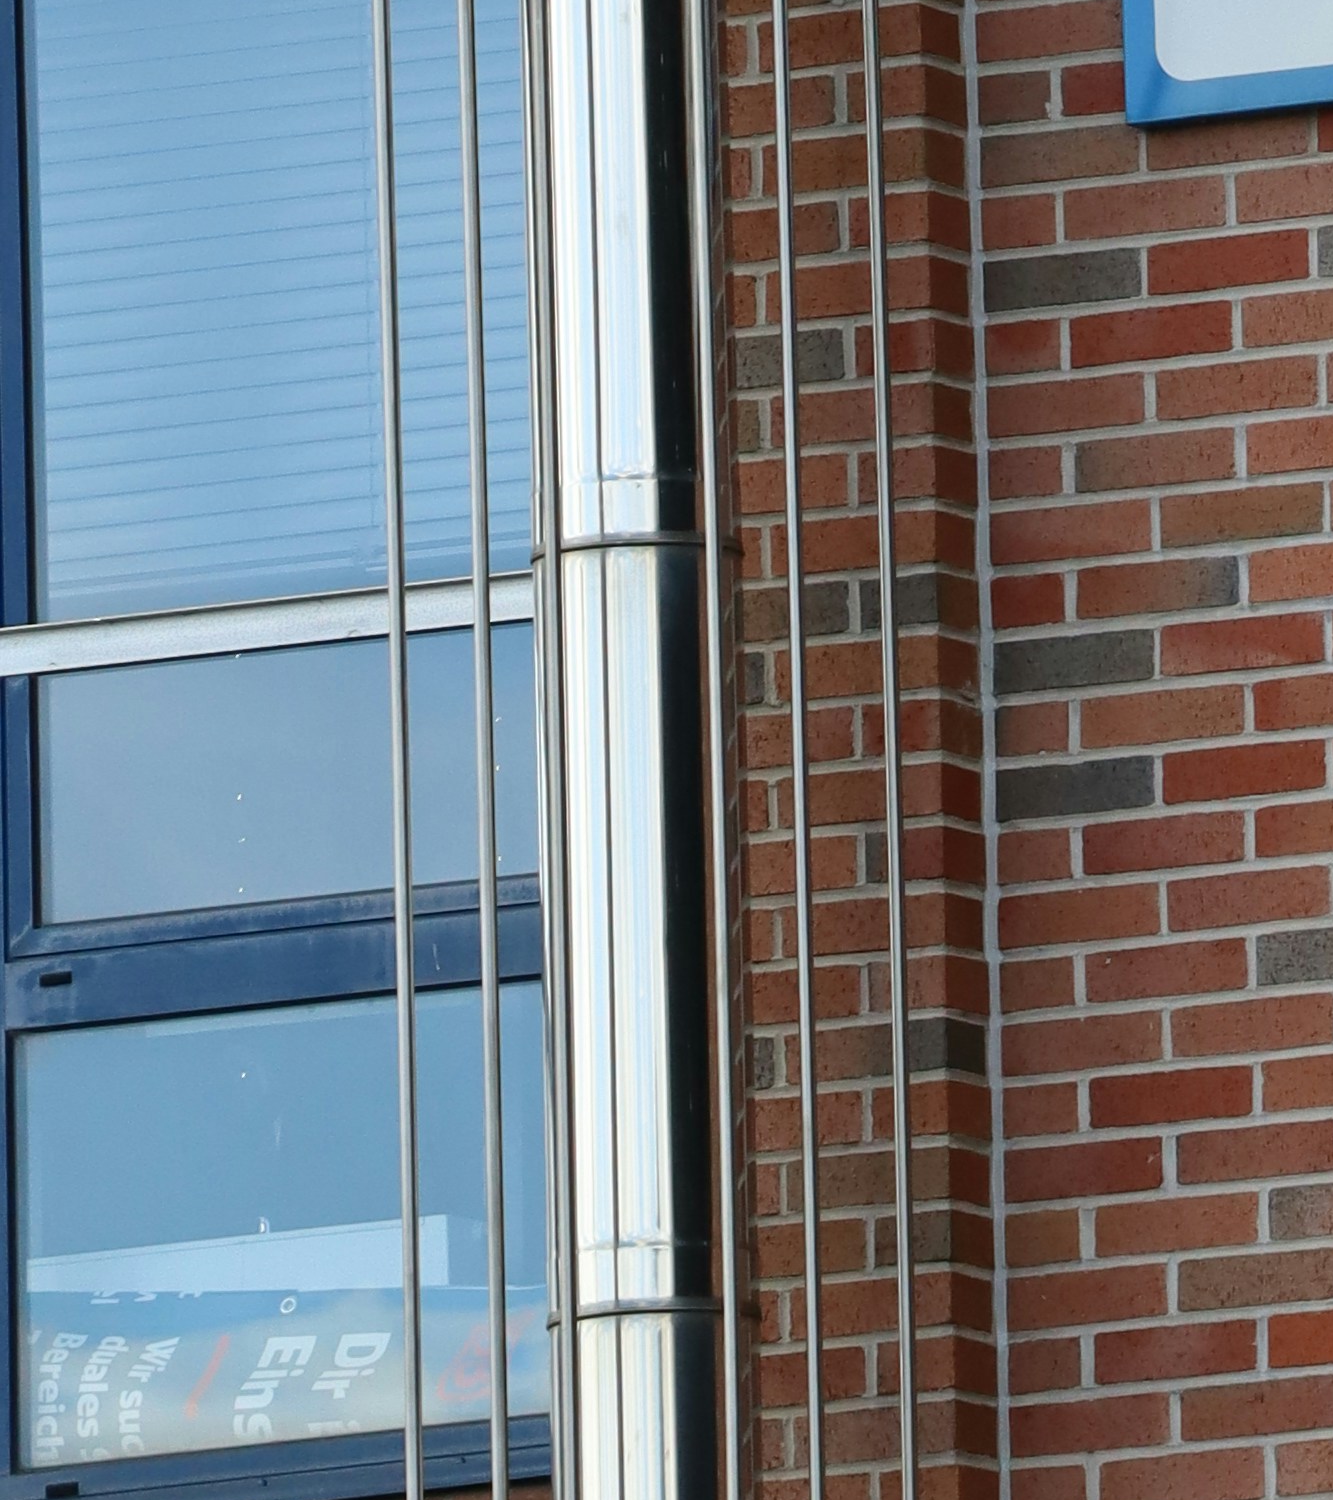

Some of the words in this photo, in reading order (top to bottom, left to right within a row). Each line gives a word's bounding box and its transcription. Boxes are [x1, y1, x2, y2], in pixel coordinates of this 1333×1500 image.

[75, 1335, 130, 1438] duales
[127, 1335, 182, 1383] Wir
[309, 1331, 392, 1400] Dir
